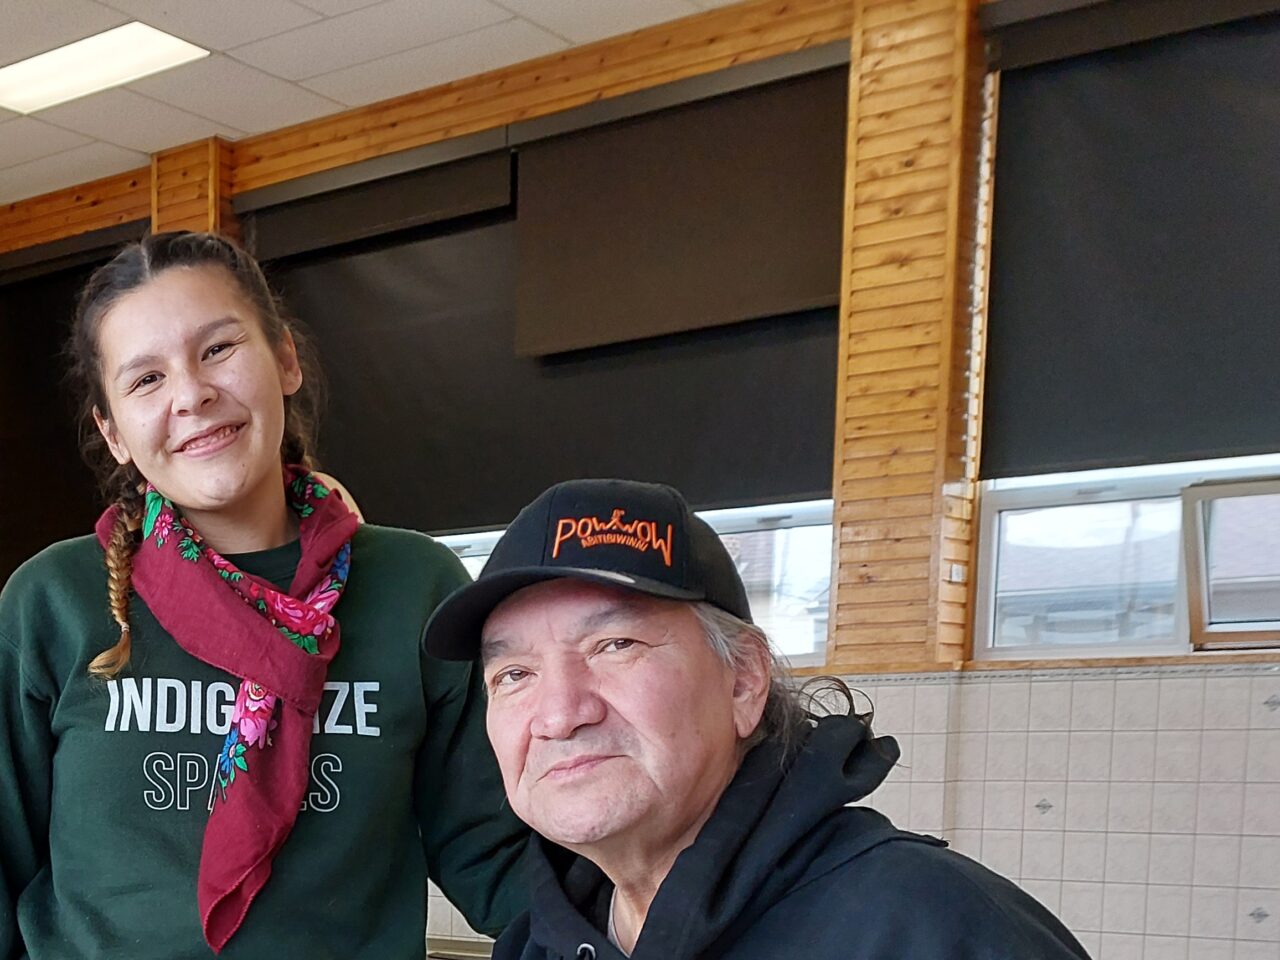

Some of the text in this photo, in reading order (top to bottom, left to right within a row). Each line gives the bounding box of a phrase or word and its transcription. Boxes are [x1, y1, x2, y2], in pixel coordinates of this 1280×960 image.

[580, 532, 650, 552] ABITIBIWINNI
[103, 676, 382, 737] INDIGZE
[142, 751, 343, 812] SPS
